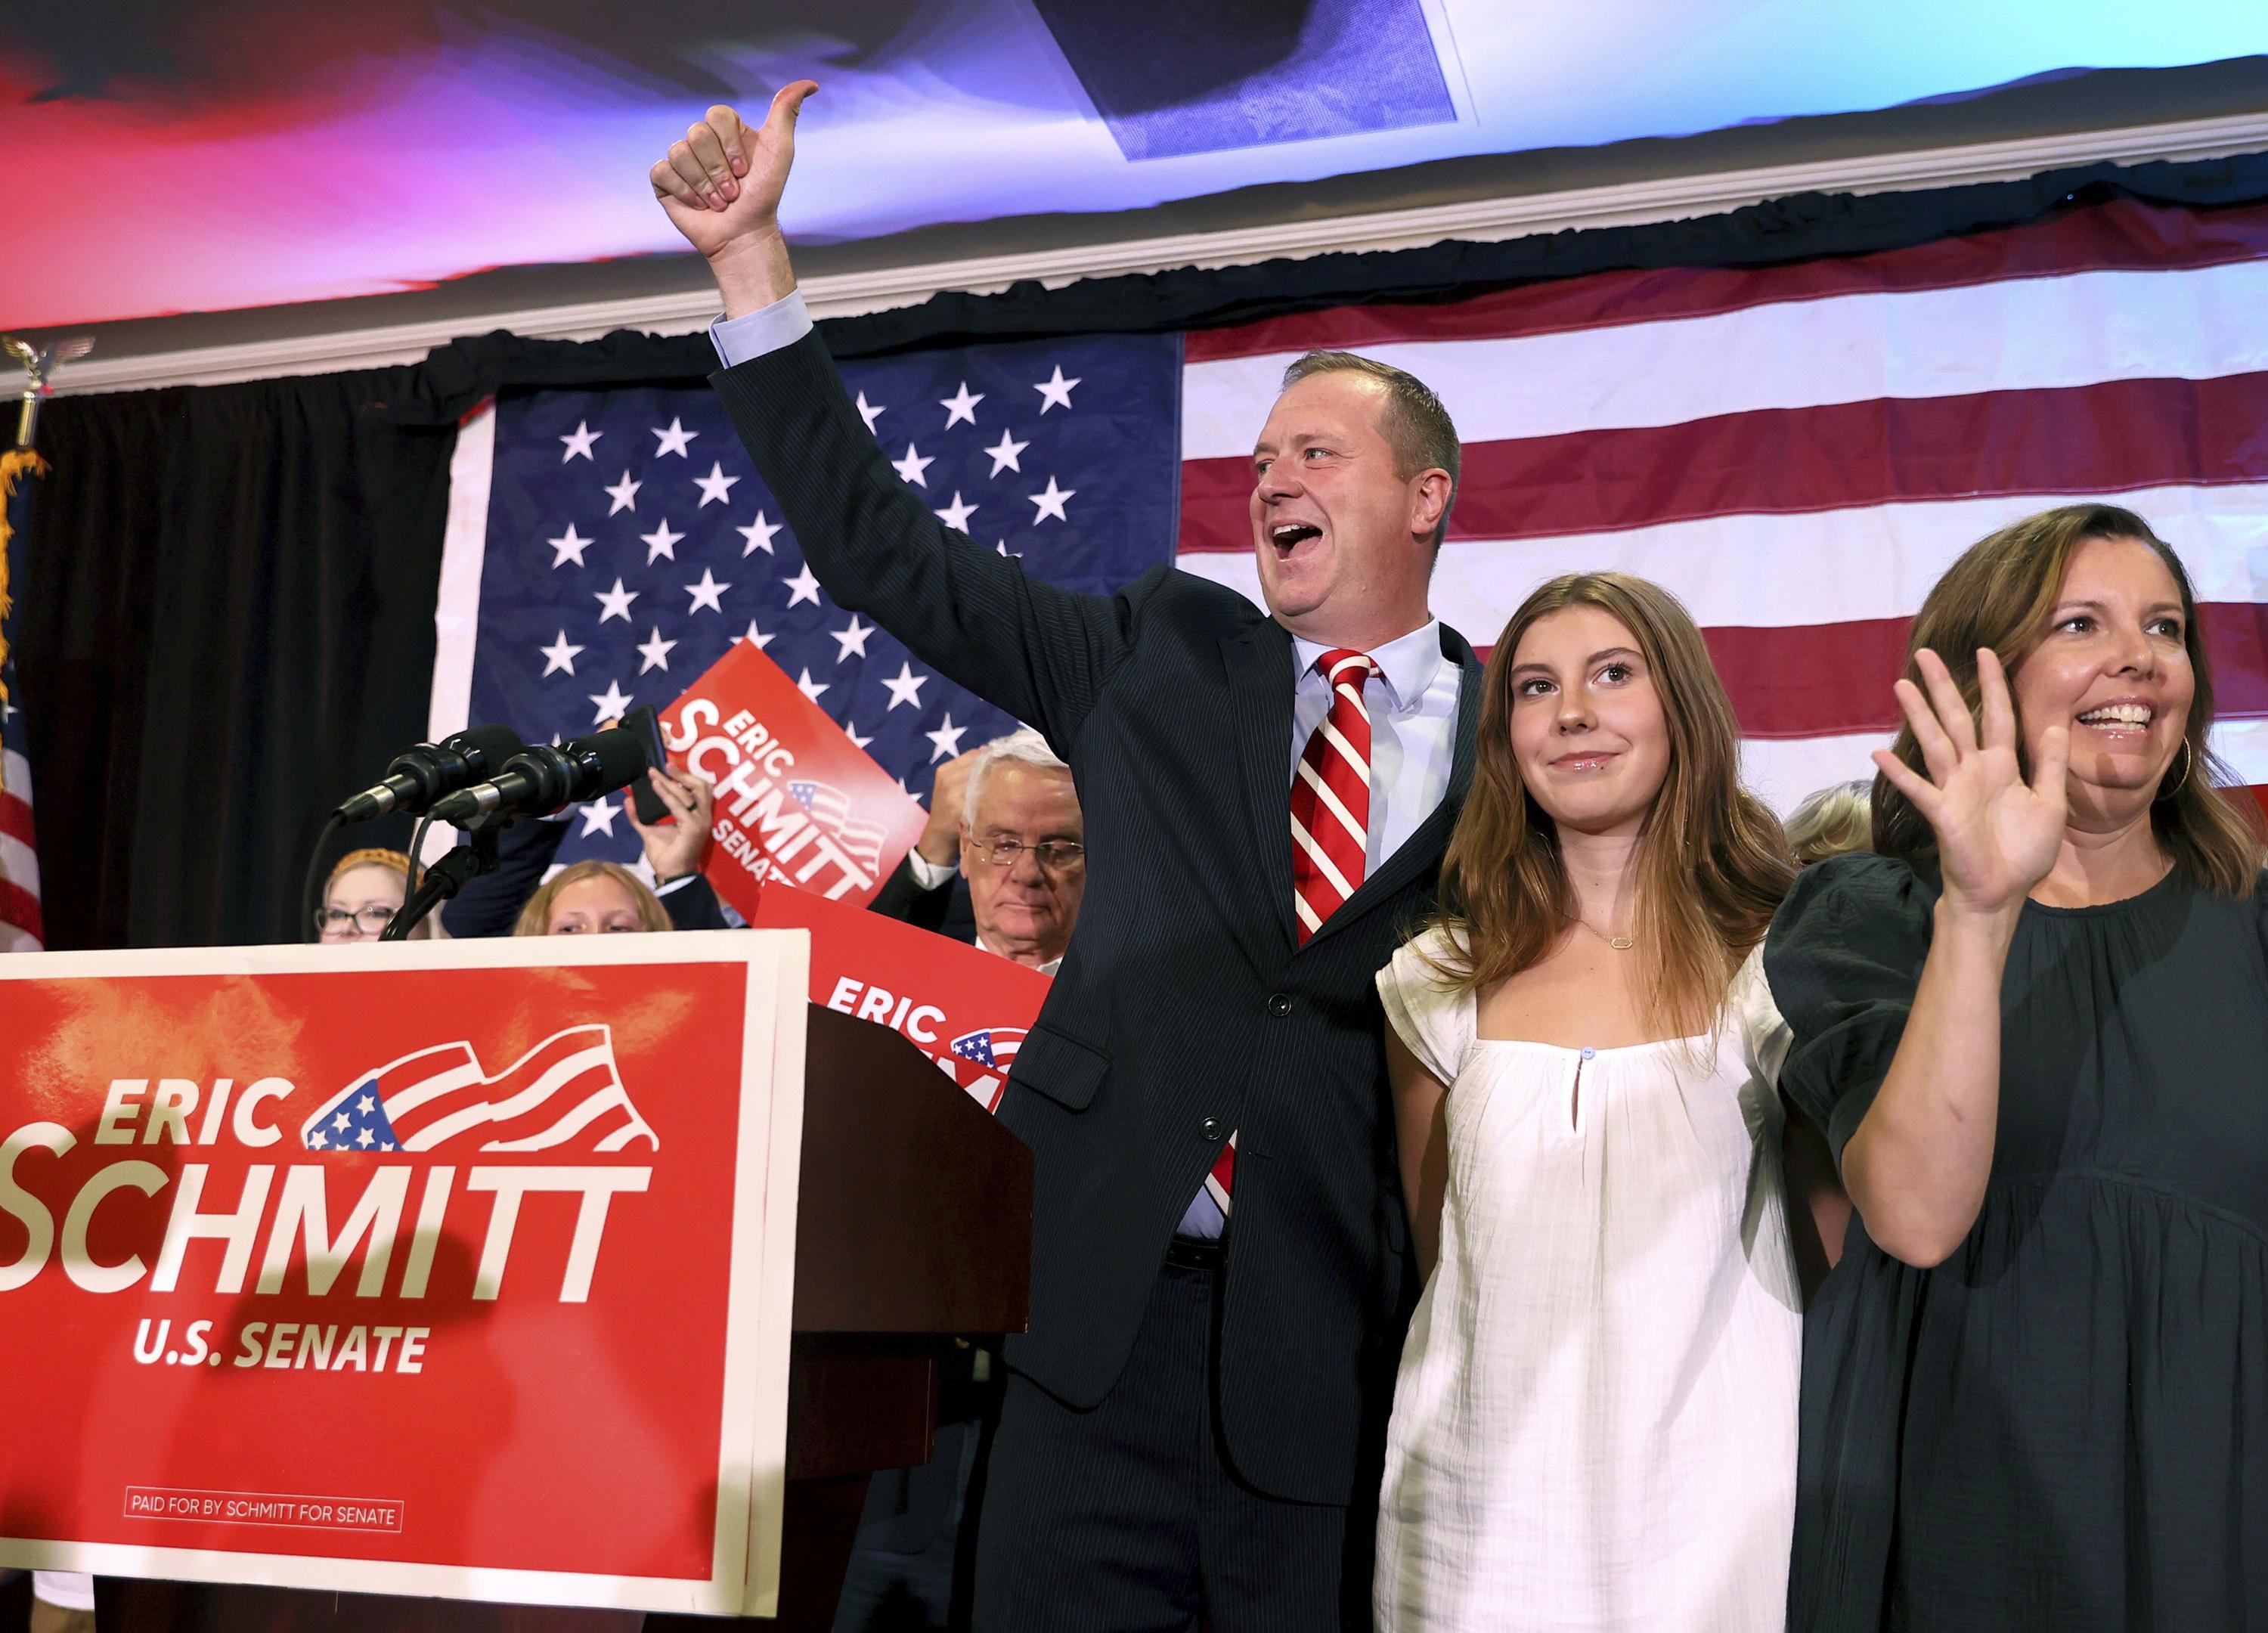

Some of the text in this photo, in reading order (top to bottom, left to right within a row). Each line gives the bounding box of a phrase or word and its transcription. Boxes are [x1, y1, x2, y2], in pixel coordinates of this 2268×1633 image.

[723, 708, 795, 777] ERIC
[659, 698, 874, 900] SCHMITT
[711, 819, 797, 888] SENAT
[827, 976, 947, 1043] ERIC
[94, 1077, 296, 1147] ERIC
[0, 1121, 652, 1303] SCHMITT
[134, 1318, 430, 1374] U.S. SENATE
[132, 1495, 395, 1525] PAID FOR BY SCHMITT FOR SENATE
